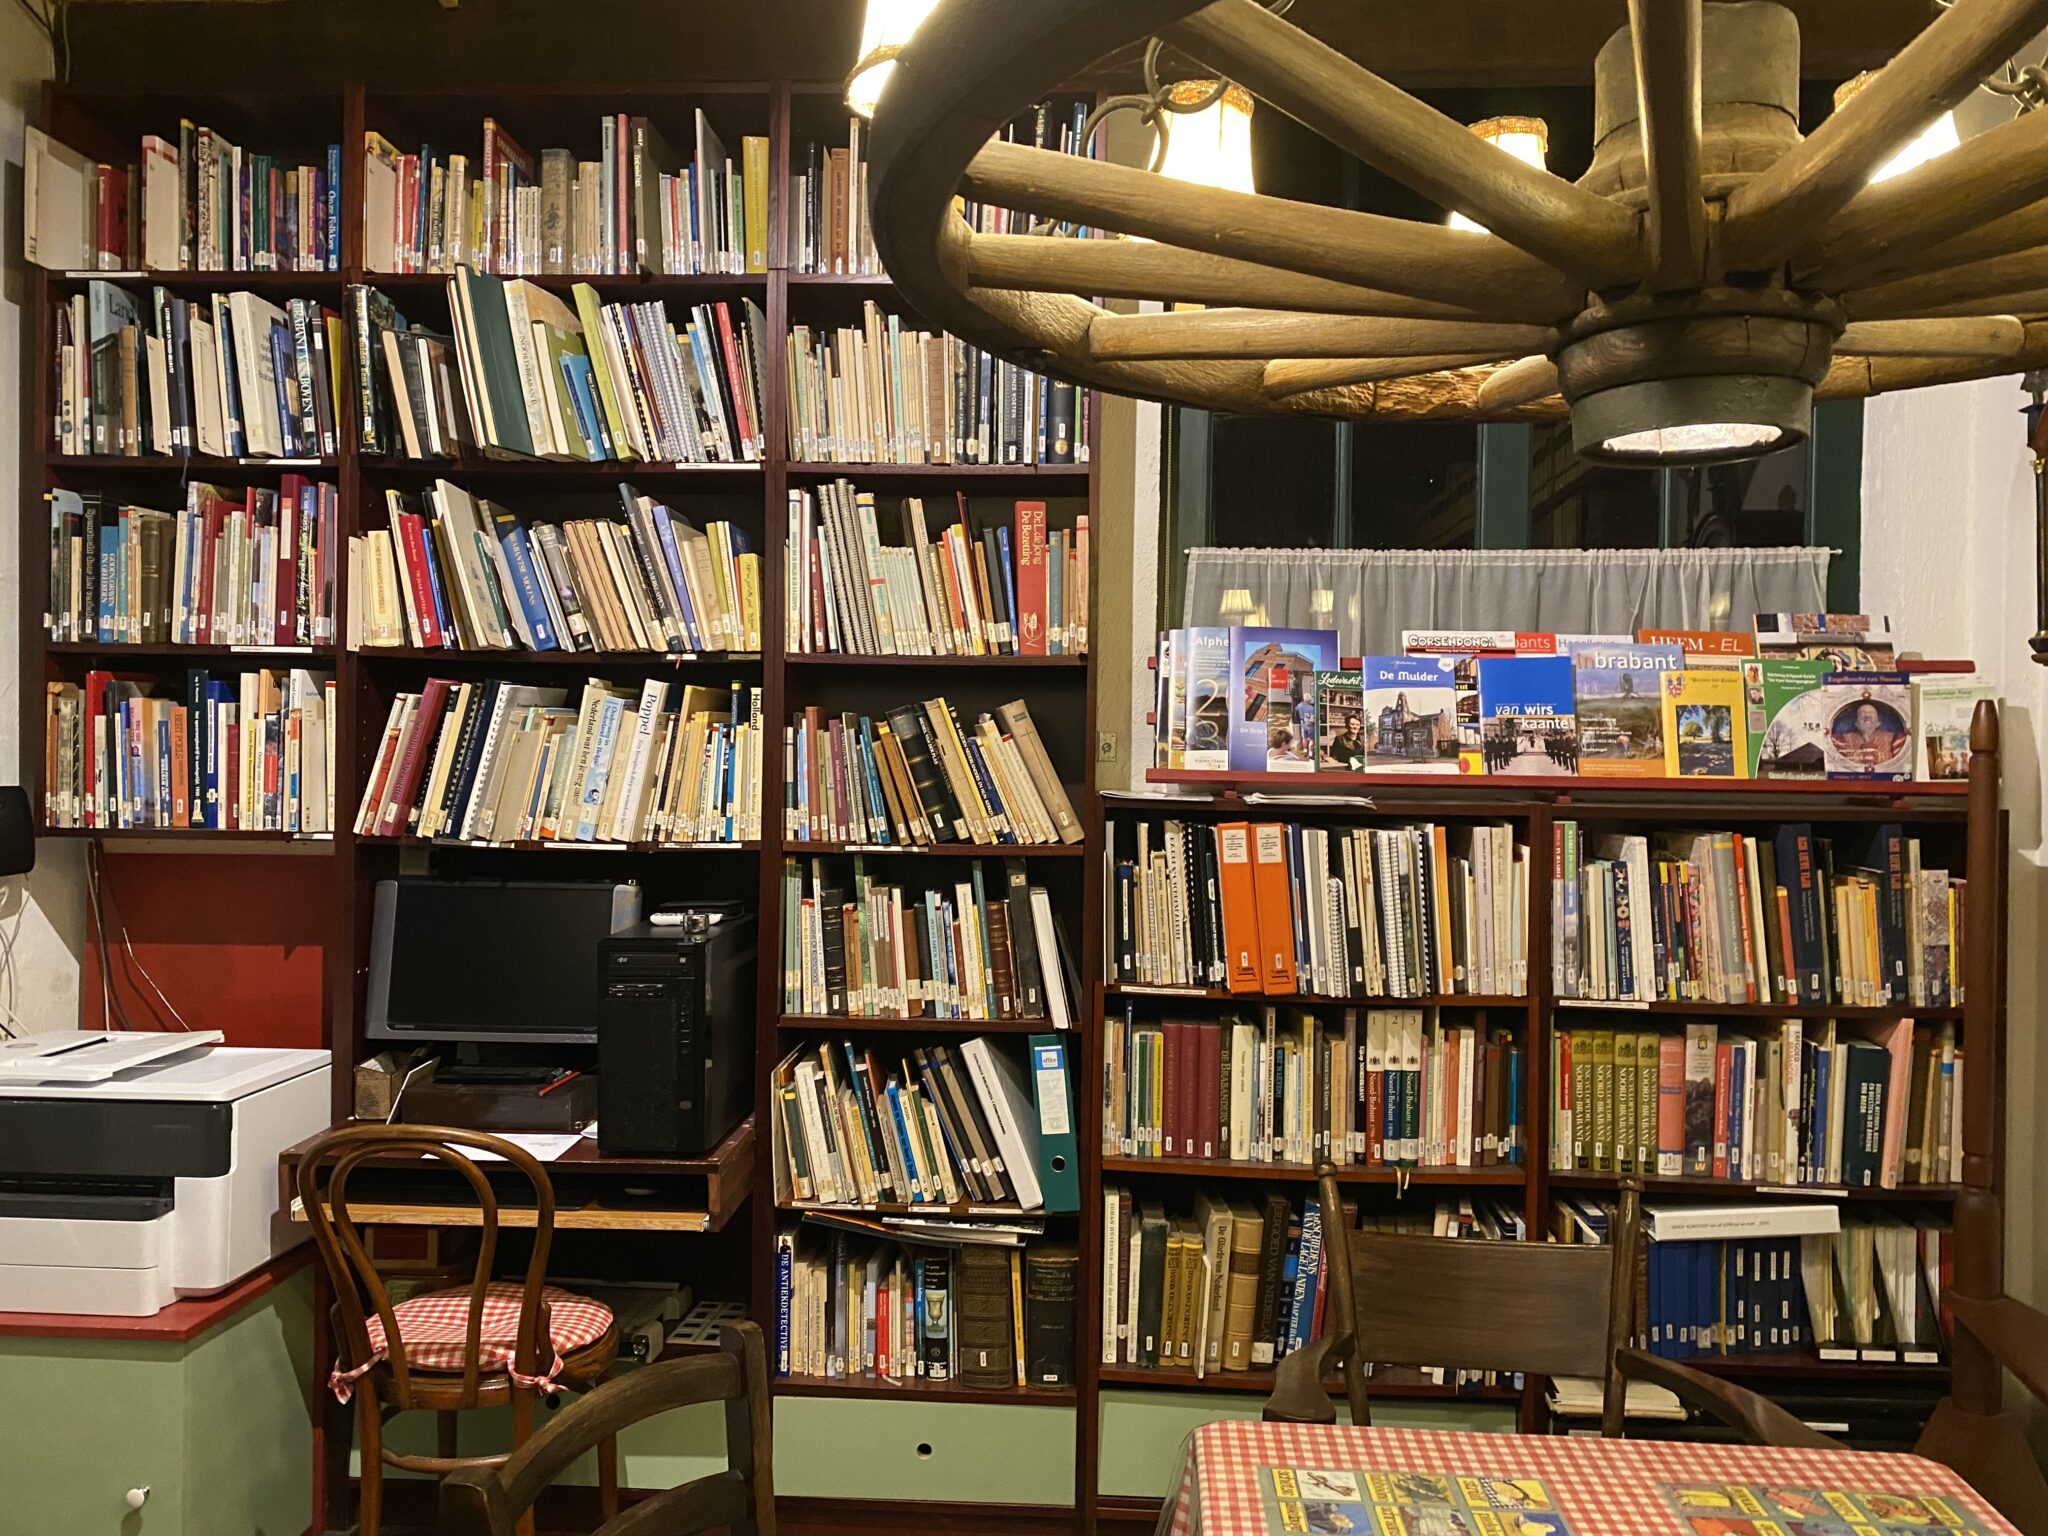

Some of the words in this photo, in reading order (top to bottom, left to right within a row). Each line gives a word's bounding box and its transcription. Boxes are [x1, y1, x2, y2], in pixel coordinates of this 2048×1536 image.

[328, 190, 337, 215] Onze
[328, 215, 337, 250] Folklore
[293, 302, 307, 350] BRABANT
[300, 377, 313, 412] BOVEN
[520, 336, 538, 404] NOORD-BRABANT
[361, 388, 372, 417] Anders
[1021, 510, 1032, 523] De
[1019, 524, 1032, 566] Bezetting
[1032, 544, 1043, 565] Jong
[643, 554, 653, 572] OUDE
[521, 576, 536, 606] MOLENS
[1195, 636, 1229, 648] Alphe
[1720, 638, 1743, 652] EL
[1380, 671, 1395, 681] De
[1398, 671, 1439, 682] Mulder
[586, 698, 601, 735] Nederland
[639, 693, 657, 736] Poppel
[751, 693, 760, 731] Holland
[1496, 705, 1519, 716] van
[1524, 704, 1554, 715] wirs
[1521, 717, 1569, 729] kaante
[1391, 1015, 1399, 1025] 2
[1410, 1015, 1416, 1025] 3
[1221, 1050, 1230, 1062] DE
[1220, 1062, 1231, 1123] BRABANDERS
[1387, 1072, 1395, 1120] Noord-Brabant
[1406, 1072, 1414, 1121] Noord-Brabant
[1641, 1068, 1649, 1144] NOORD-BRABANT
[1269, 1206, 1284, 1255] ERFGOED
[1308, 1212, 1322, 1274] GESCHIEDENIS
[781, 1253, 790, 1265] DE
[1215, 1236, 1227, 1259] Glorie
[1299, 1241, 1309, 1264] LAGE
[1266, 1257, 1279, 1281] VAN
[1294, 1265, 1307, 1301] LANDEN
[1212, 1273, 1224, 1311] Nederland
[780, 1267, 789, 1350] ANTIEKDETECTIVE
[1261, 1284, 1275, 1343] NEDERLAN
